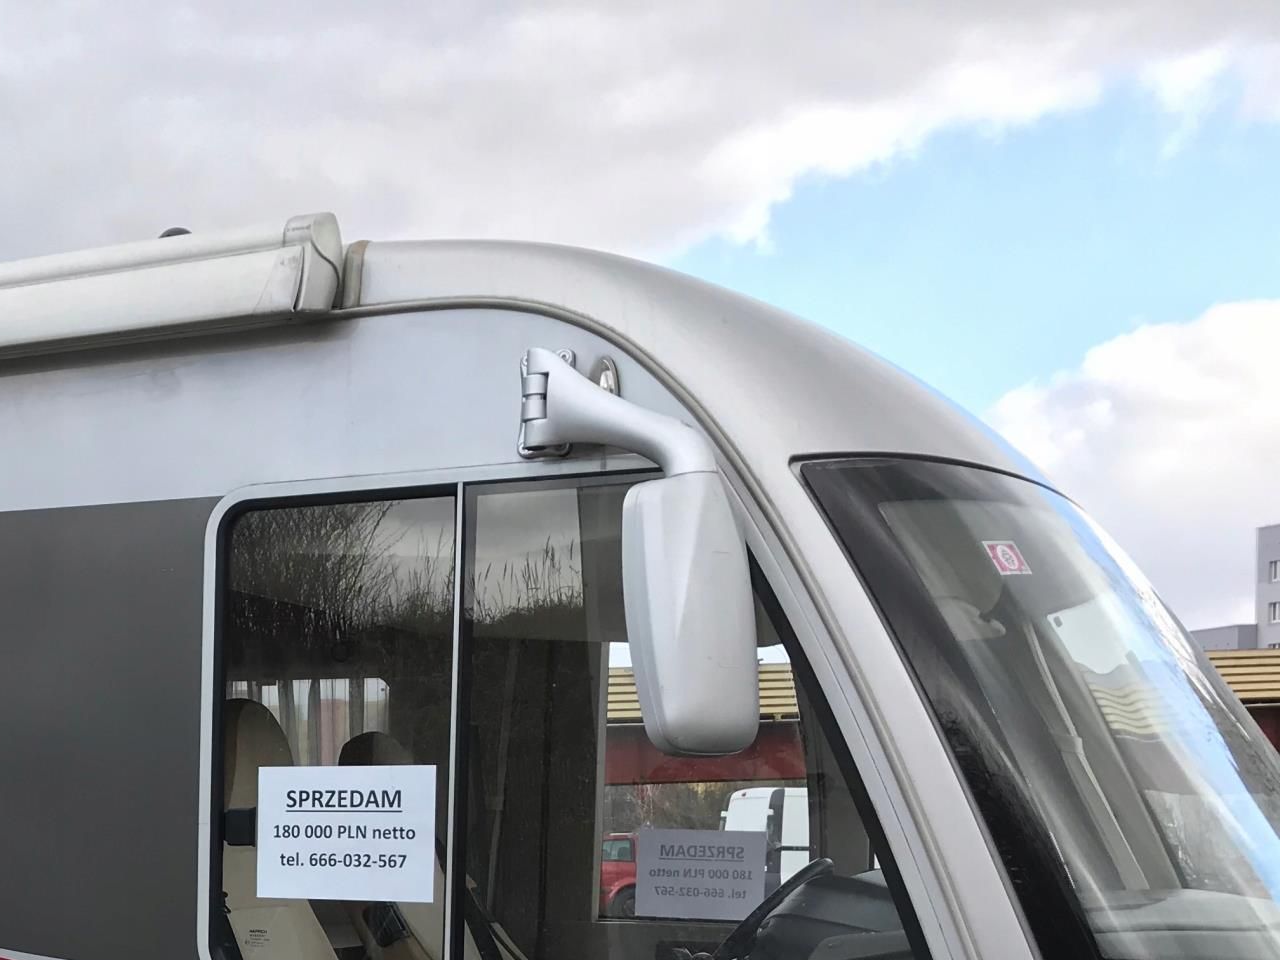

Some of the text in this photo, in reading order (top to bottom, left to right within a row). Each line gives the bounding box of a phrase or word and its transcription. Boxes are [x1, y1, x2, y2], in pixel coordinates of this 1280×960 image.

[285, 788, 403, 811] SPRZEDAM
[273, 824, 416, 840] 180 000 PLN netto
[279, 852, 408, 868] tel. 666-032-567
